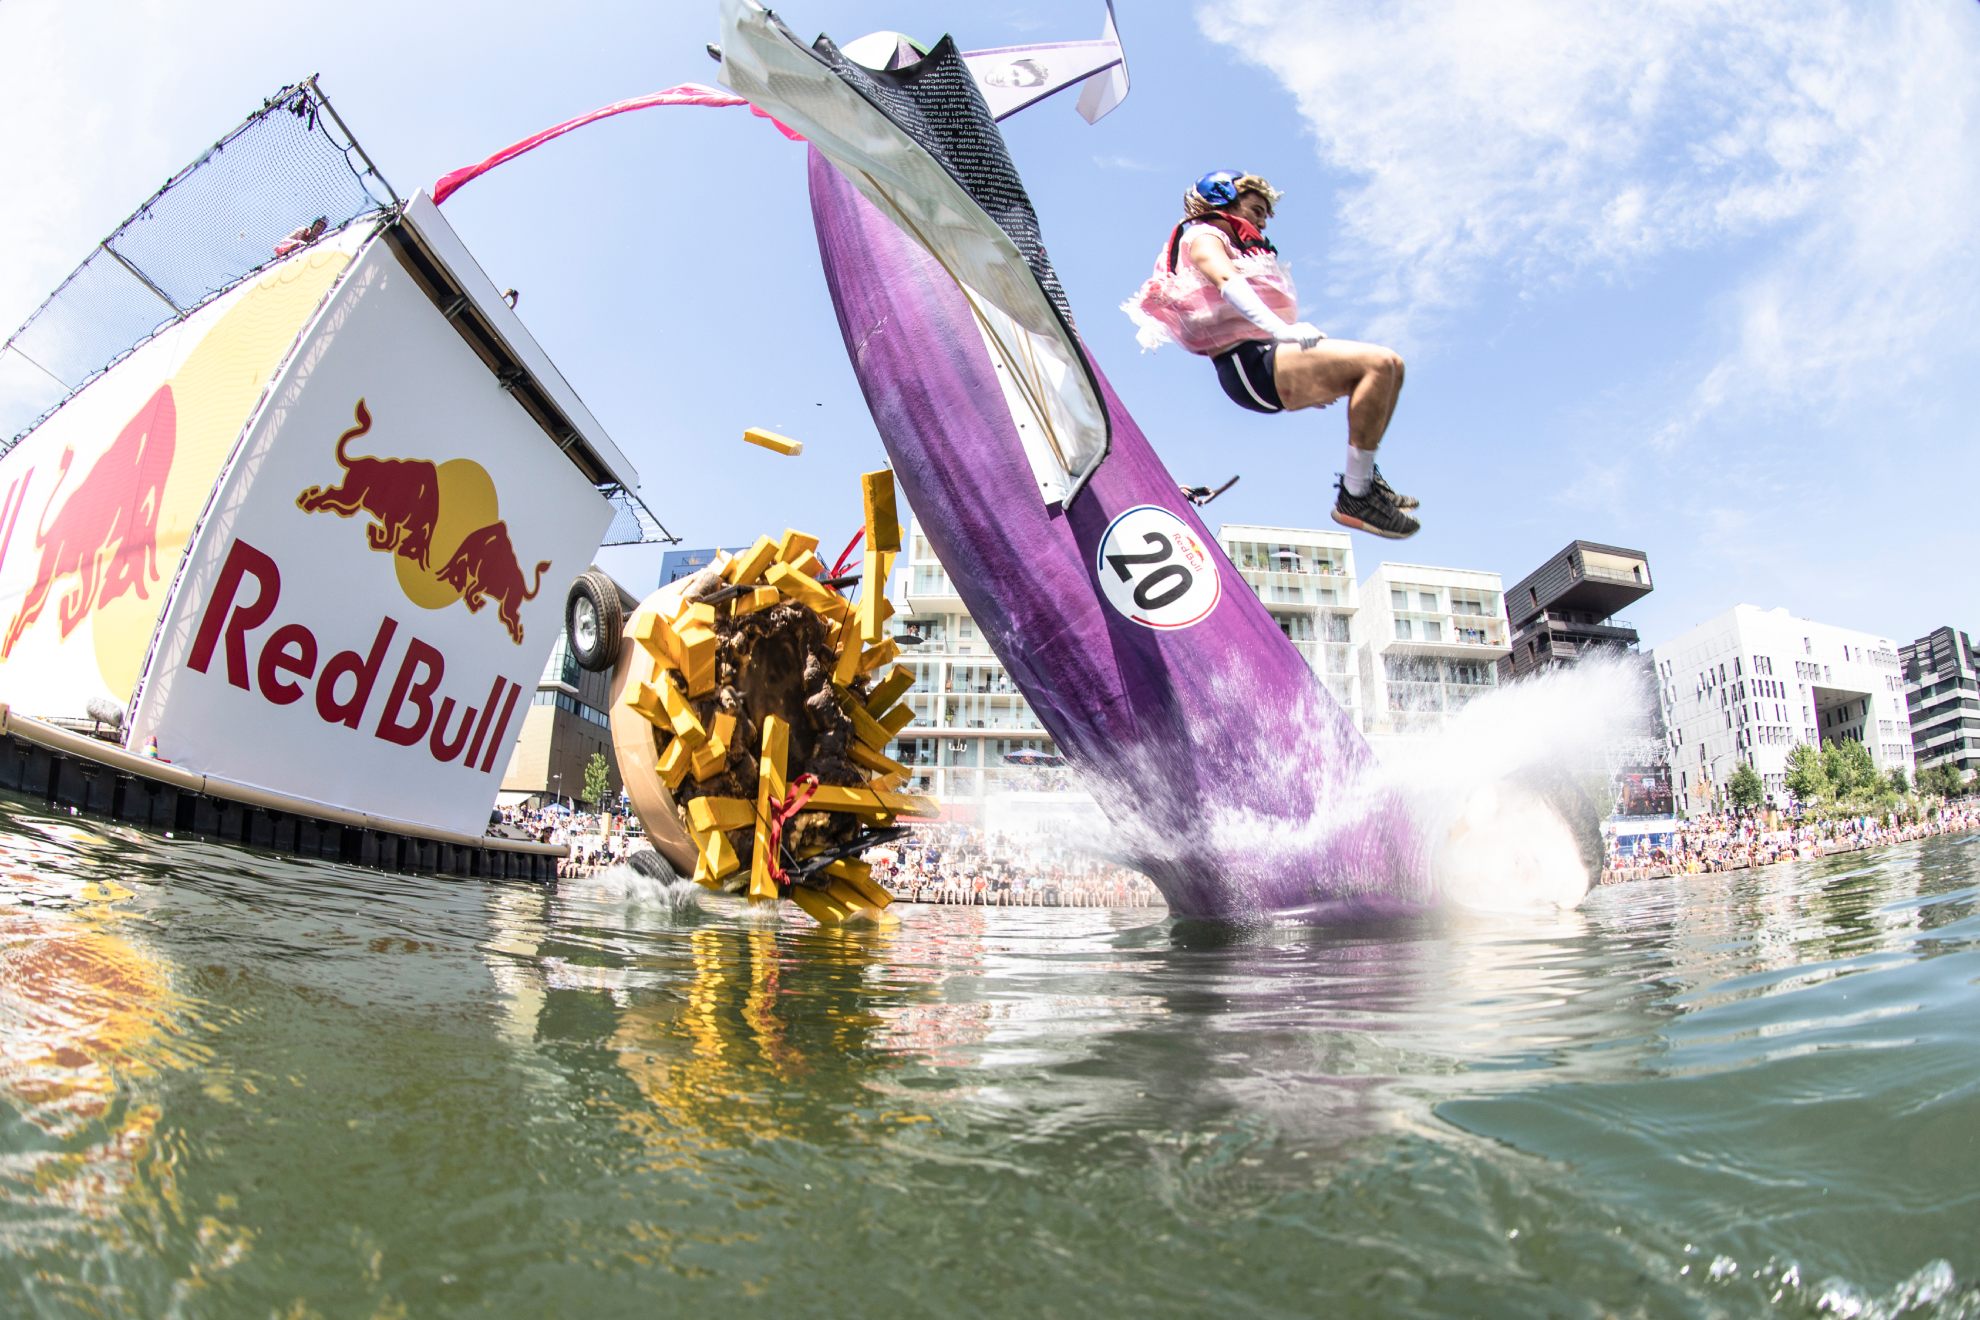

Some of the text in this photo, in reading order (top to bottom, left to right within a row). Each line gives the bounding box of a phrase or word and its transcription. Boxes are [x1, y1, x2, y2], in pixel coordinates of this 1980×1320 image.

[1105, 531, 1194, 610] 20
[1172, 532, 1204, 573] Red Bull
[186, 538, 522, 775] Red Bull
